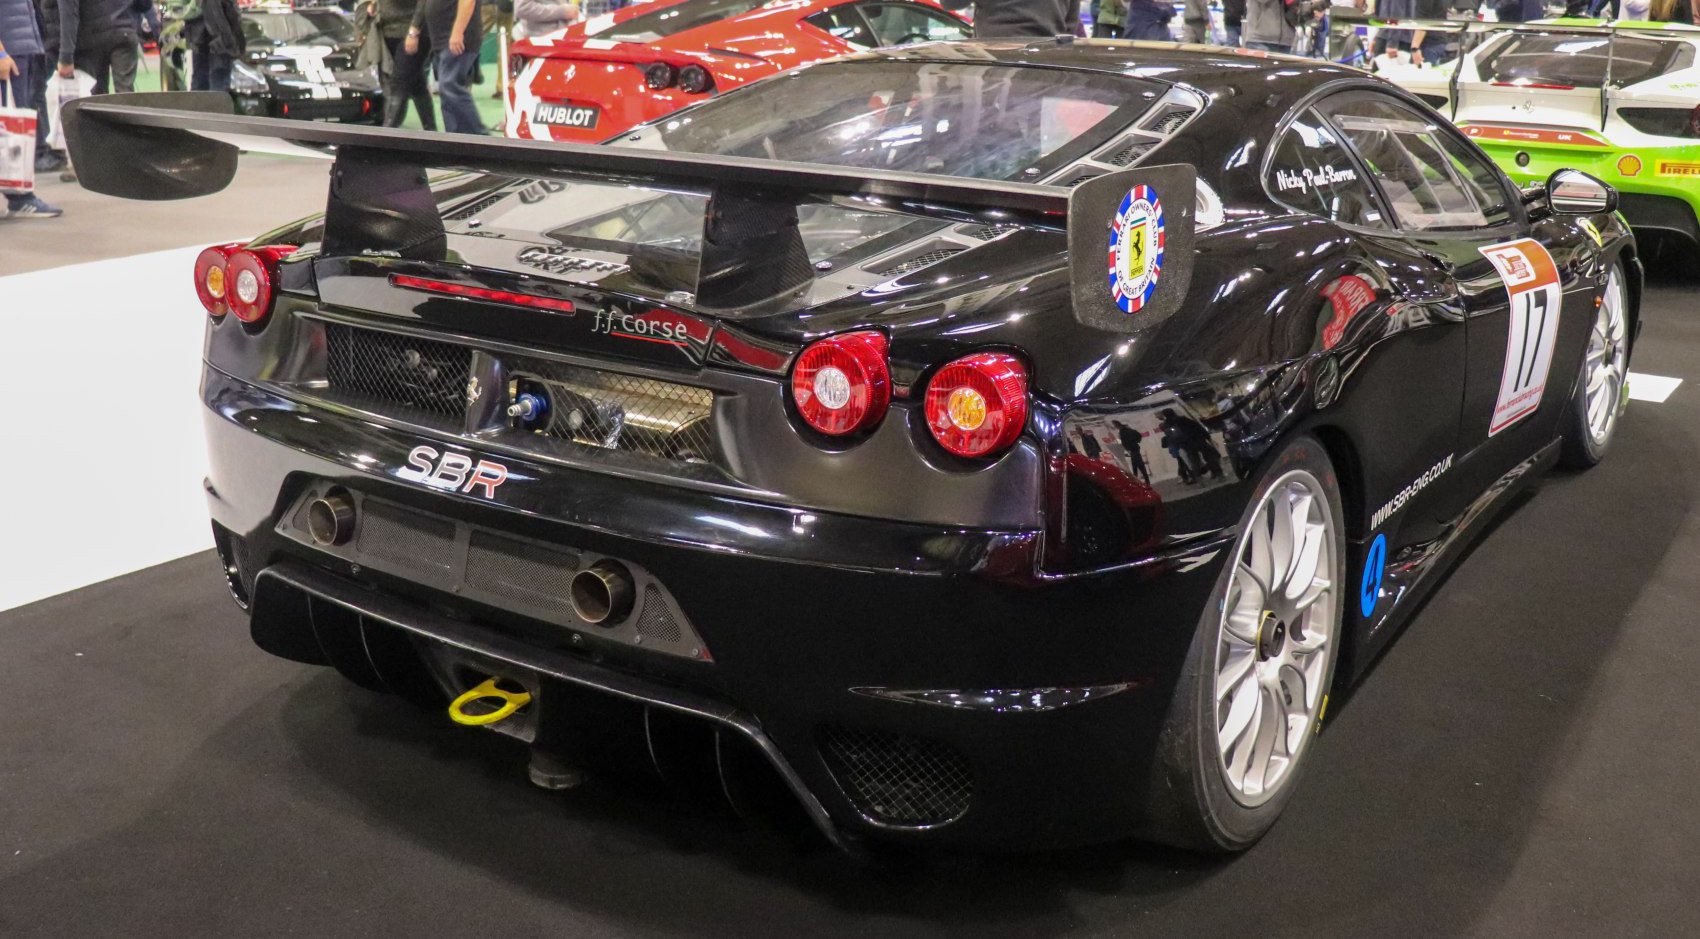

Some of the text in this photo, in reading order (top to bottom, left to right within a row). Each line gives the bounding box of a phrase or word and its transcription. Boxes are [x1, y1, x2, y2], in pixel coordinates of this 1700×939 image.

[537, 106, 593, 126] HUBLOT
[1558, 133, 1572, 141] UK
[1276, 169, 1307, 195] Nicky
[1661, 162, 1700, 174] PIREL
[1116, 212, 1130, 261] FERRARI
[1122, 282, 1138, 296] GREAT
[1138, 257, 1155, 292] BRITAIN
[1513, 288, 1548, 393] 17
[395, 445, 508, 499] SBR
[1370, 452, 1454, 531] WWW.SBR-ENG.CO.UK
[1365, 543, 1380, 603] 4
